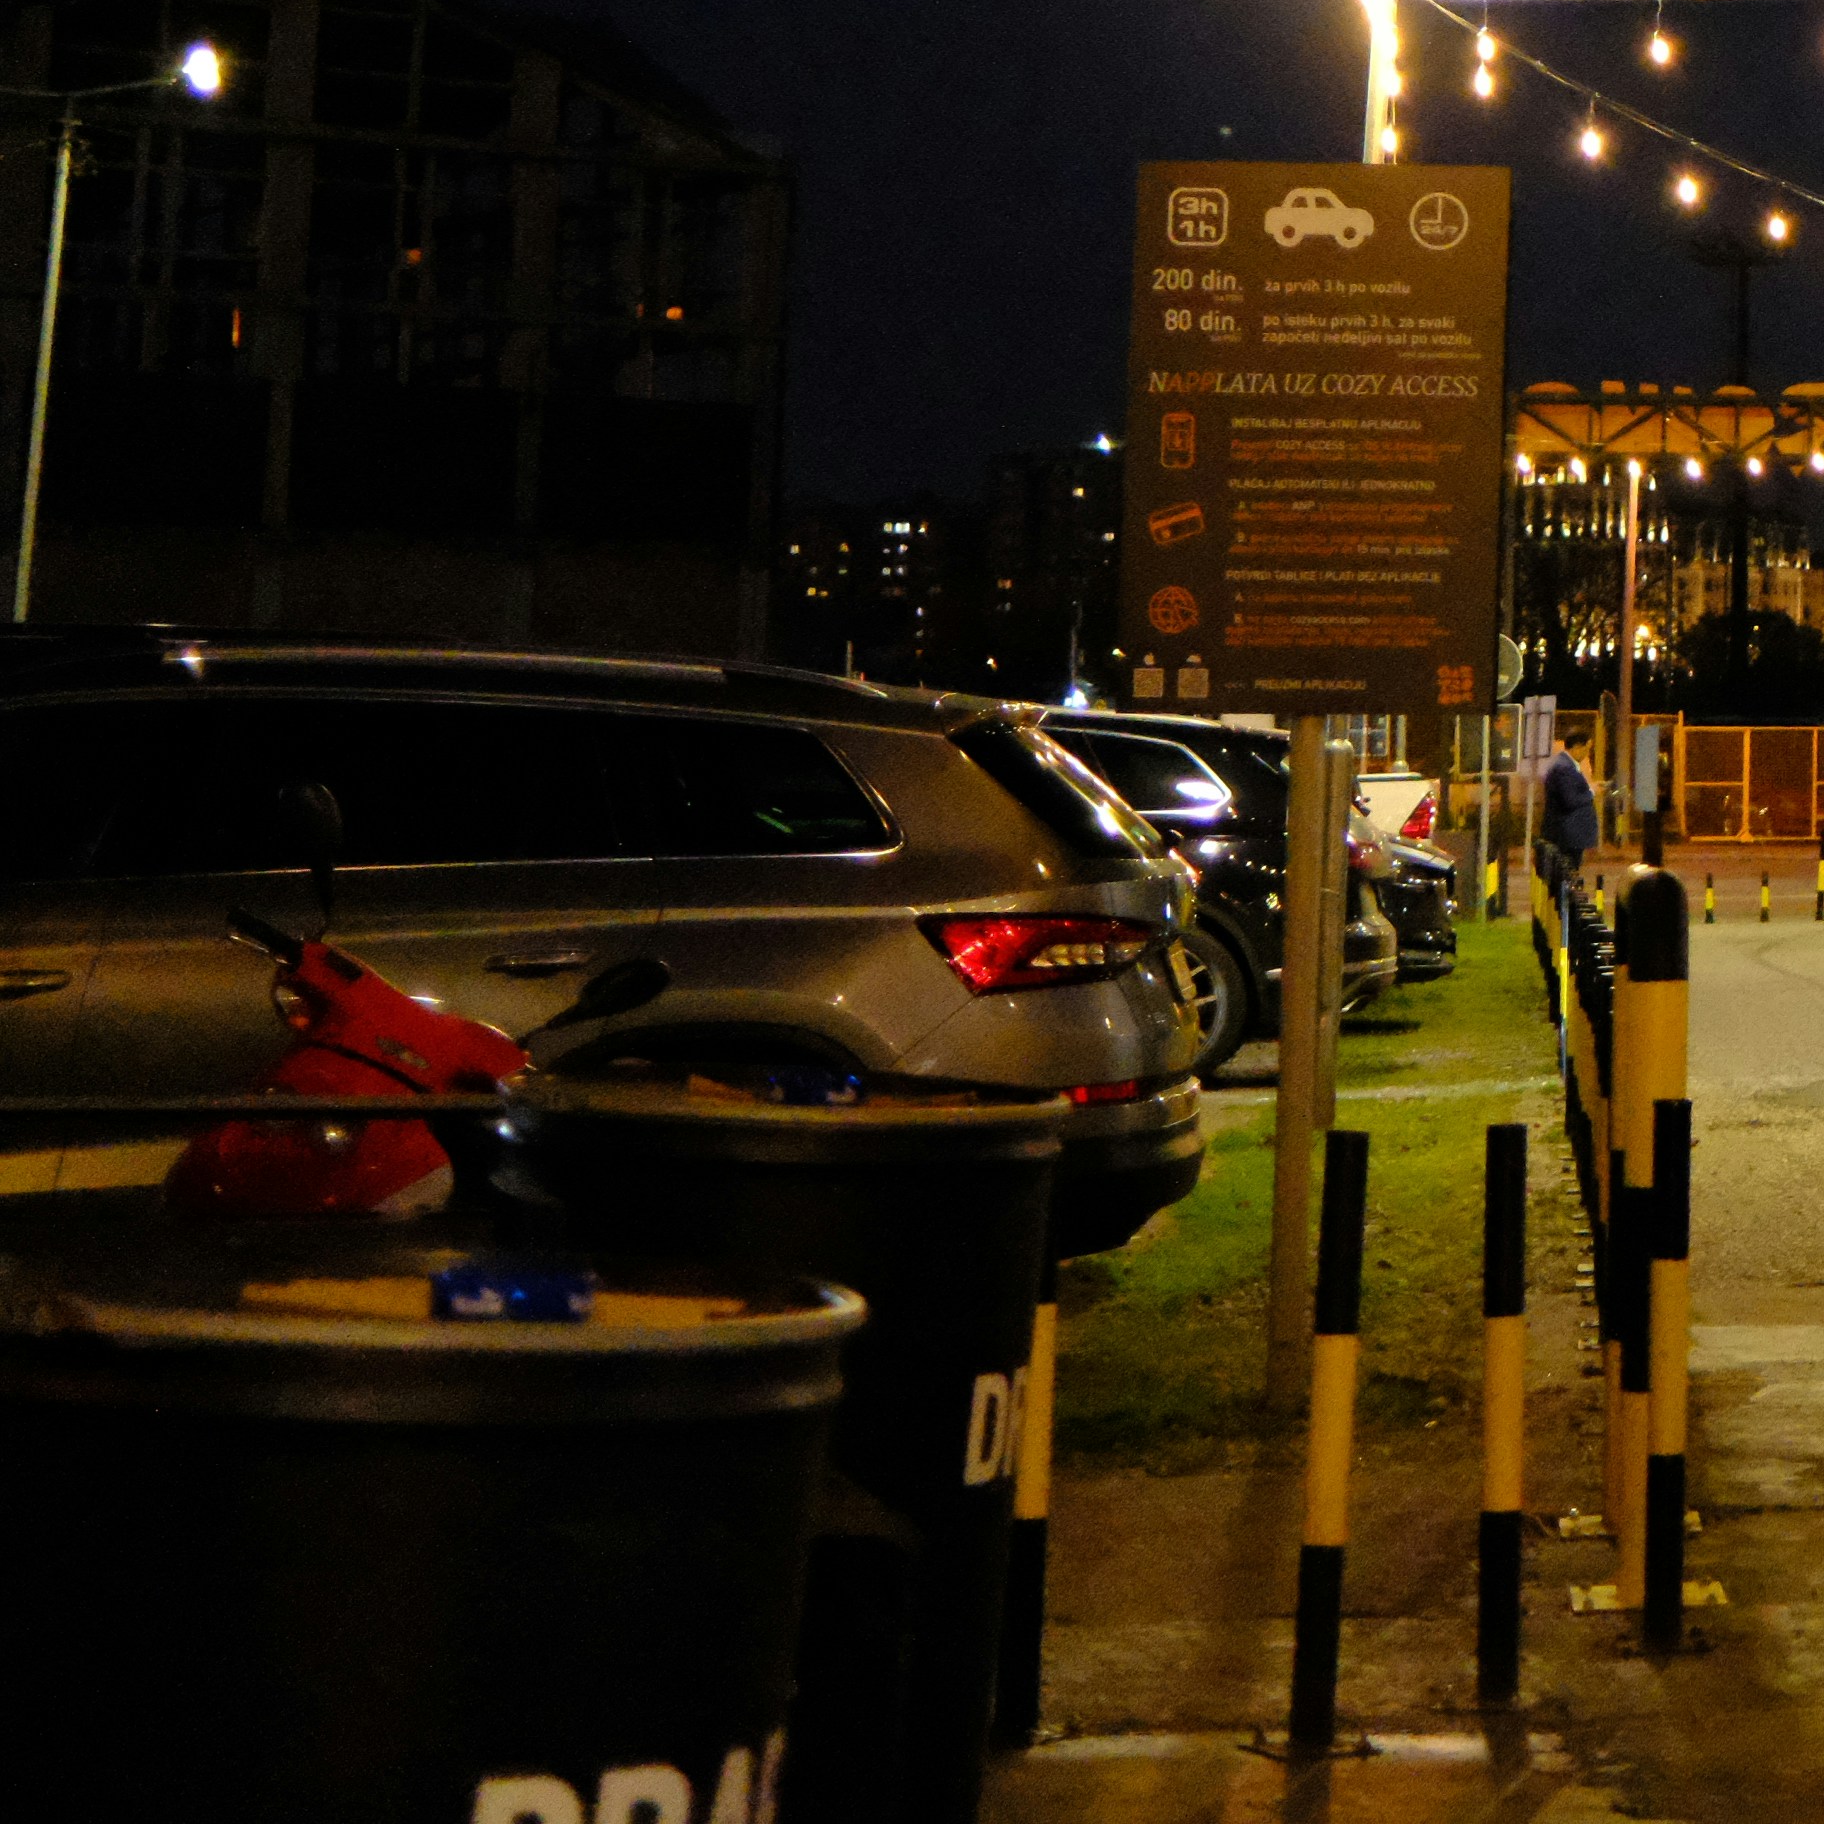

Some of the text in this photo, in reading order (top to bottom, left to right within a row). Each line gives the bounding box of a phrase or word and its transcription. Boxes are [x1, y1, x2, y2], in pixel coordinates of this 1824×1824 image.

[1177, 197, 1218, 215] 3h
[1178, 221, 1217, 238] 1h
[1152, 268, 1244, 291] 200 din.
[1265, 279, 1411, 297] za prvih 3 h po vozilu
[1165, 308, 1242, 332] 80 din.
[1263, 315, 1281, 330] po
[1331, 315, 1367, 330] prvih
[1370, 315, 1378, 328] 3
[1398, 318, 1416, 329] za
[1419, 316, 1456, 329] svaki
[1386, 333, 1407, 345] sat
[1411, 334, 1428, 347] po
[1432, 332, 1472, 346] vozilu
[1148, 371, 1479, 398] NAPPLATA UZ COZY ACCESS
